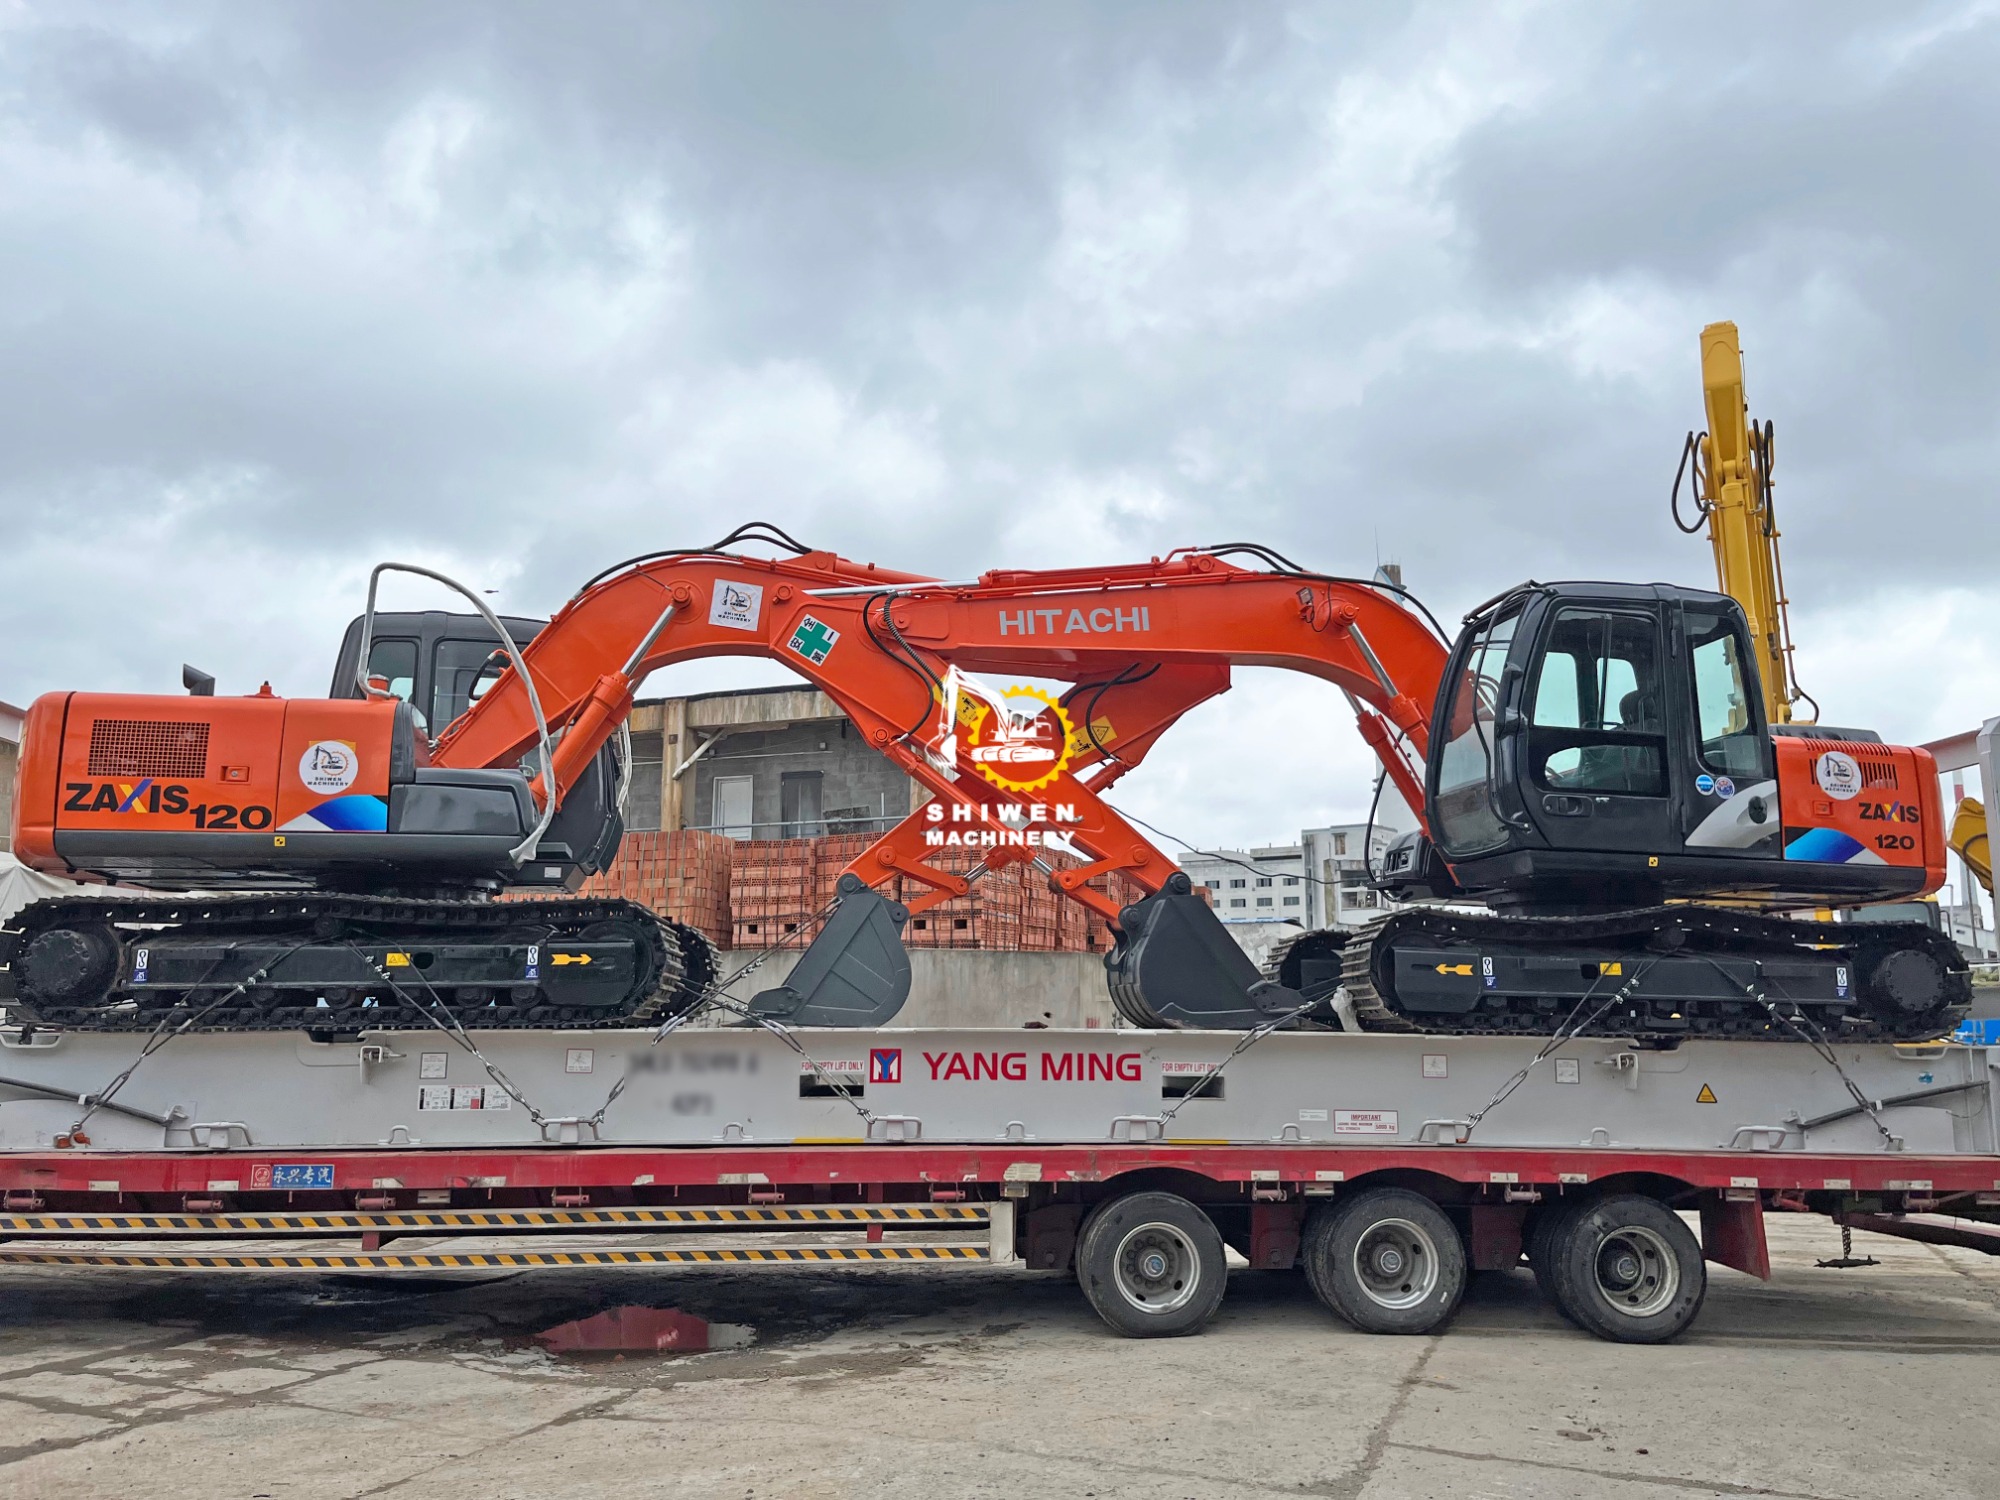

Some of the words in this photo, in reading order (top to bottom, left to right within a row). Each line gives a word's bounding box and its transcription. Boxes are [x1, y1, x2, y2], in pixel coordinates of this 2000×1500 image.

[999, 607, 1150, 636] HITACHI
[64, 779, 190, 814] ZAXIS
[189, 805, 272, 830] 120
[1859, 801, 1920, 823] ZAXIS
[1875, 834, 1915, 850] 120
[834, 1062, 847, 1070] LIFT
[848, 1062, 863, 1070] ONLY
[922, 1052, 1027, 1081] YANG
[1041, 1053, 1142, 1081] MING
[1162, 1062, 1173, 1072] FOR
[1174, 1062, 1193, 1072] EMPTY
[1194, 1063, 1205, 1072] LIFT
